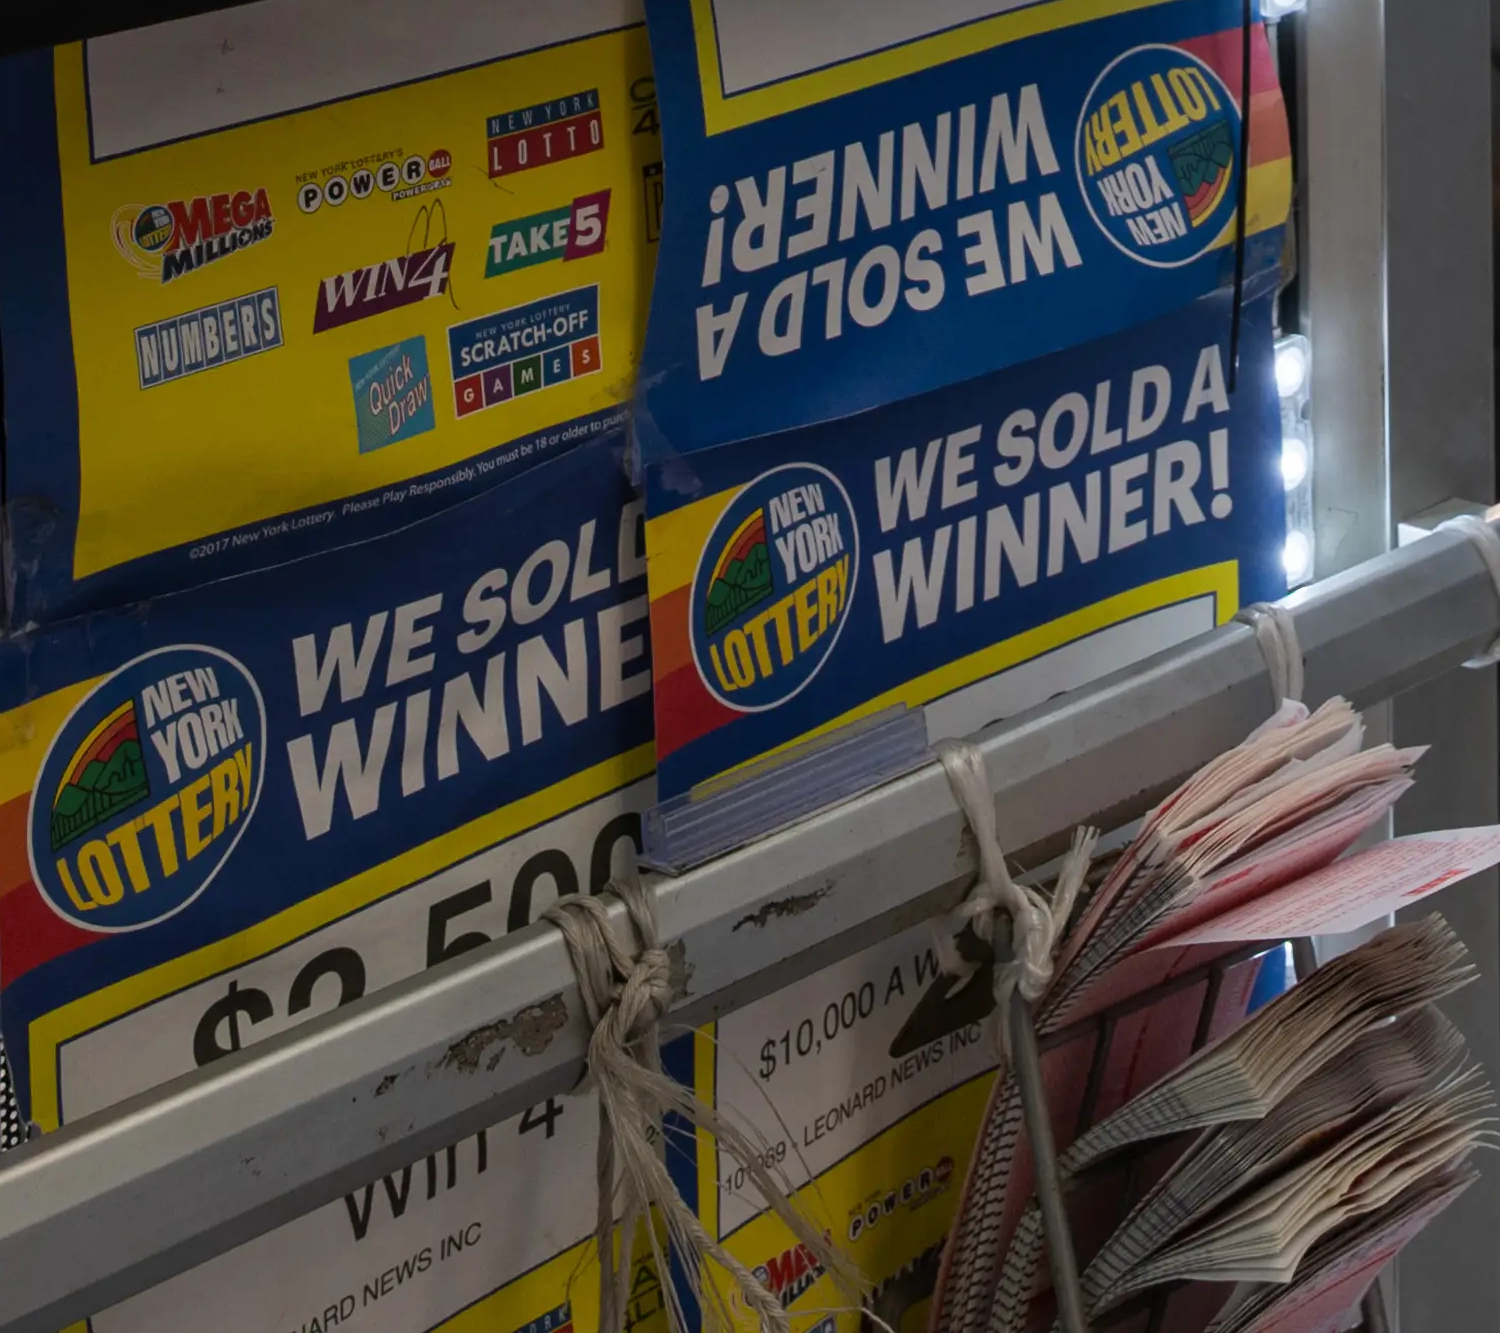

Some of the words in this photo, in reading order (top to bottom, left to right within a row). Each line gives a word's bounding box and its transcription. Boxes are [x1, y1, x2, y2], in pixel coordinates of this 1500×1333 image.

[491, 110, 533, 135] NEW
[544, 92, 596, 122] YORK
[492, 119, 600, 172] LOTTO
[1084, 65, 1222, 177] LOTTERY
[166, 188, 274, 253] MEGA
[700, 83, 1061, 288] WINNER!
[1097, 154, 1173, 217] YORK
[1126, 201, 1188, 247] NEW
[161, 219, 275, 284] MILLIONS
[964, 192, 1083, 296] WE
[140, 297, 277, 380] NUMBERS
[460, 309, 589, 367] SCRATCH-OFF
[694, 294, 747, 382] A
[757, 238, 947, 358] SOLD
[369, 353, 414, 416] Quick
[388, 376, 429, 437] Draw
[463, 347, 591, 404] GAMES
[874, 420, 980, 532] WE
[994, 378, 1174, 475] SOLD
[1182, 345, 1230, 425] A
[232, 532, 261, 548] New
[261, 521, 289, 539] York
[341, 492, 381, 516] Please
[382, 486, 408, 508] Play
[477, 459, 496, 476] You
[495, 447, 520, 468] must
[560, 421, 590, 444] older
[768, 481, 826, 529] NEW
[772, 517, 843, 585] YORK
[872, 427, 1234, 642] WINNER!
[291, 592, 444, 717] WE
[710, 550, 850, 693] LOTTERY
[140, 672, 224, 740] NEW
[147, 695, 244, 785] YORK
[286, 594, 652, 840] WINNE
[54, 741, 255, 914] LOTTERY
[758, 981, 875, 1083] $10,000
[883, 965, 906, 1006] A
[803, 1076, 887, 1147] LEONARD
[890, 1044, 945, 1085] NEWS
[949, 1021, 982, 1055] INC
[362, 1247, 433, 1307] NEWS
[440, 1222, 483, 1262] INC
